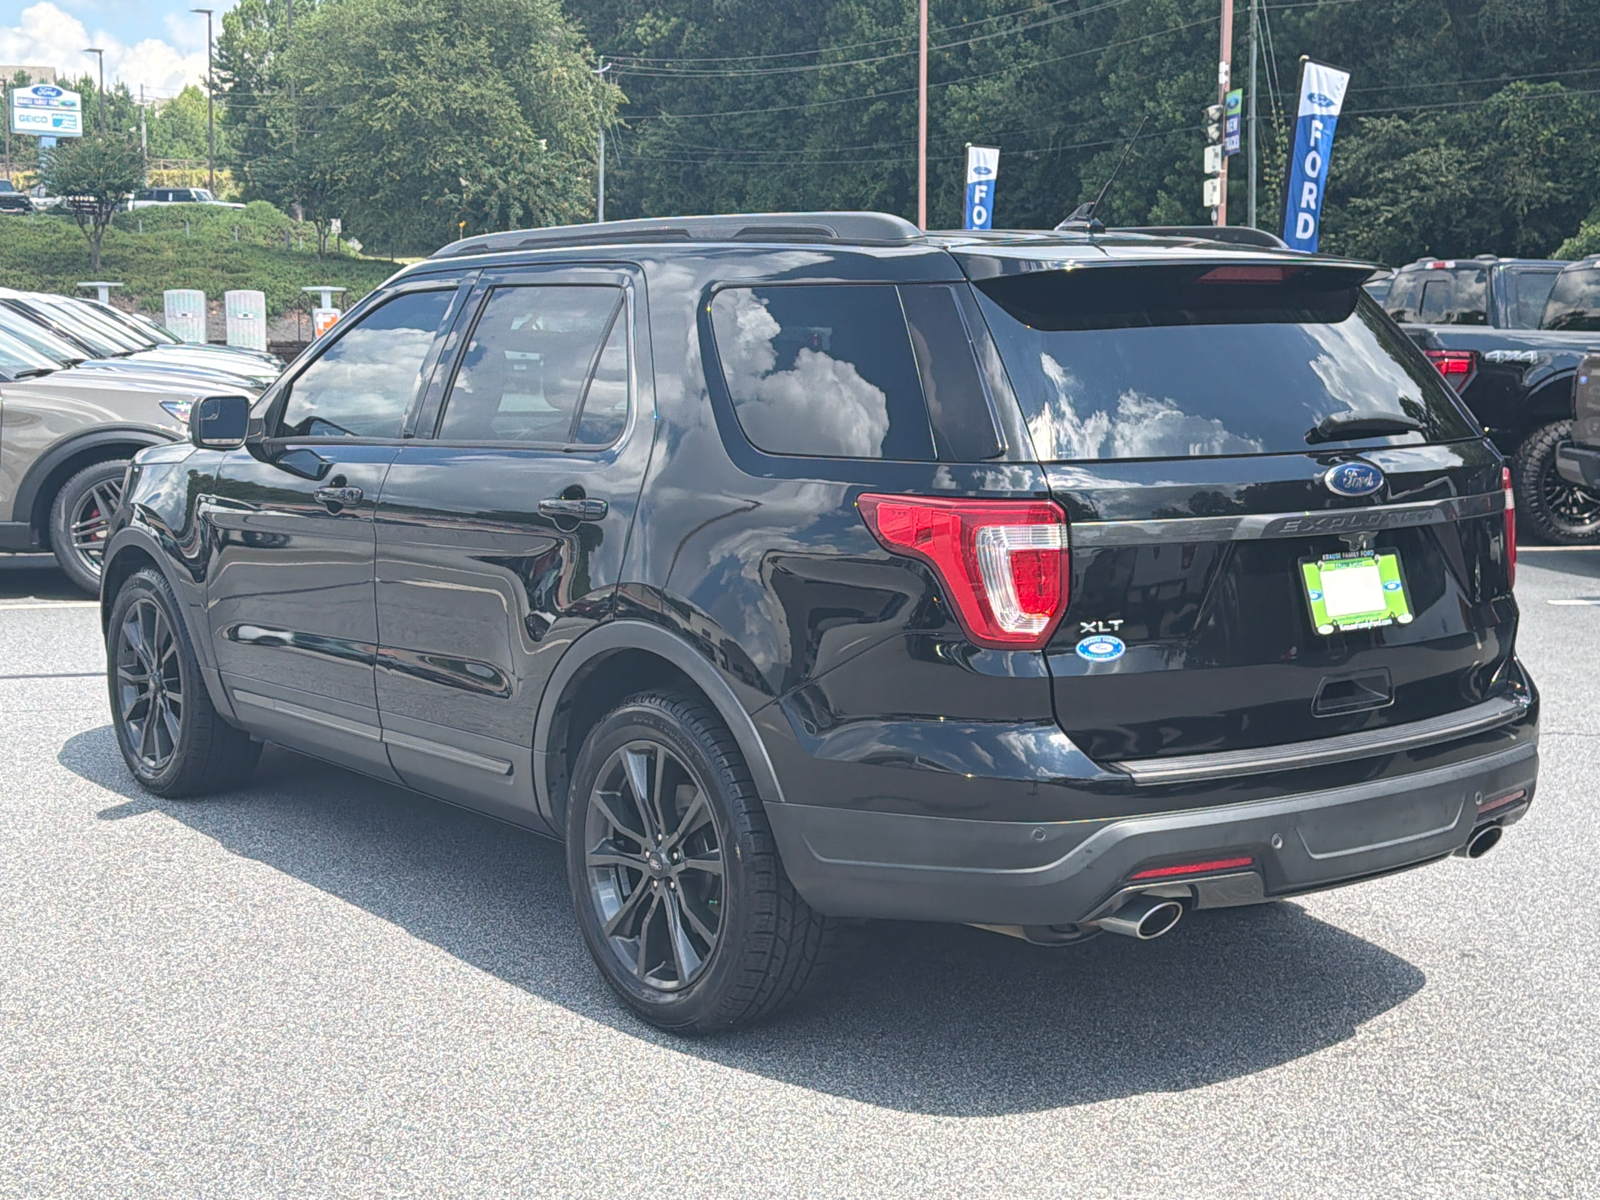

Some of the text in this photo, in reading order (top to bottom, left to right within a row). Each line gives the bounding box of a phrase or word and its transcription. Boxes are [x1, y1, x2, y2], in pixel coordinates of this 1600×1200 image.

[37, 86, 57, 96] Ford
[18, 114, 48, 124] GEICO
[1295, 119, 1324, 240] FORD
[972, 184, 988, 230] FO
[1342, 467, 1374, 488] Ford
[1322, 549, 1375, 561] KRAUSE FAMILY FORD
[1079, 619, 1124, 634] XLT
